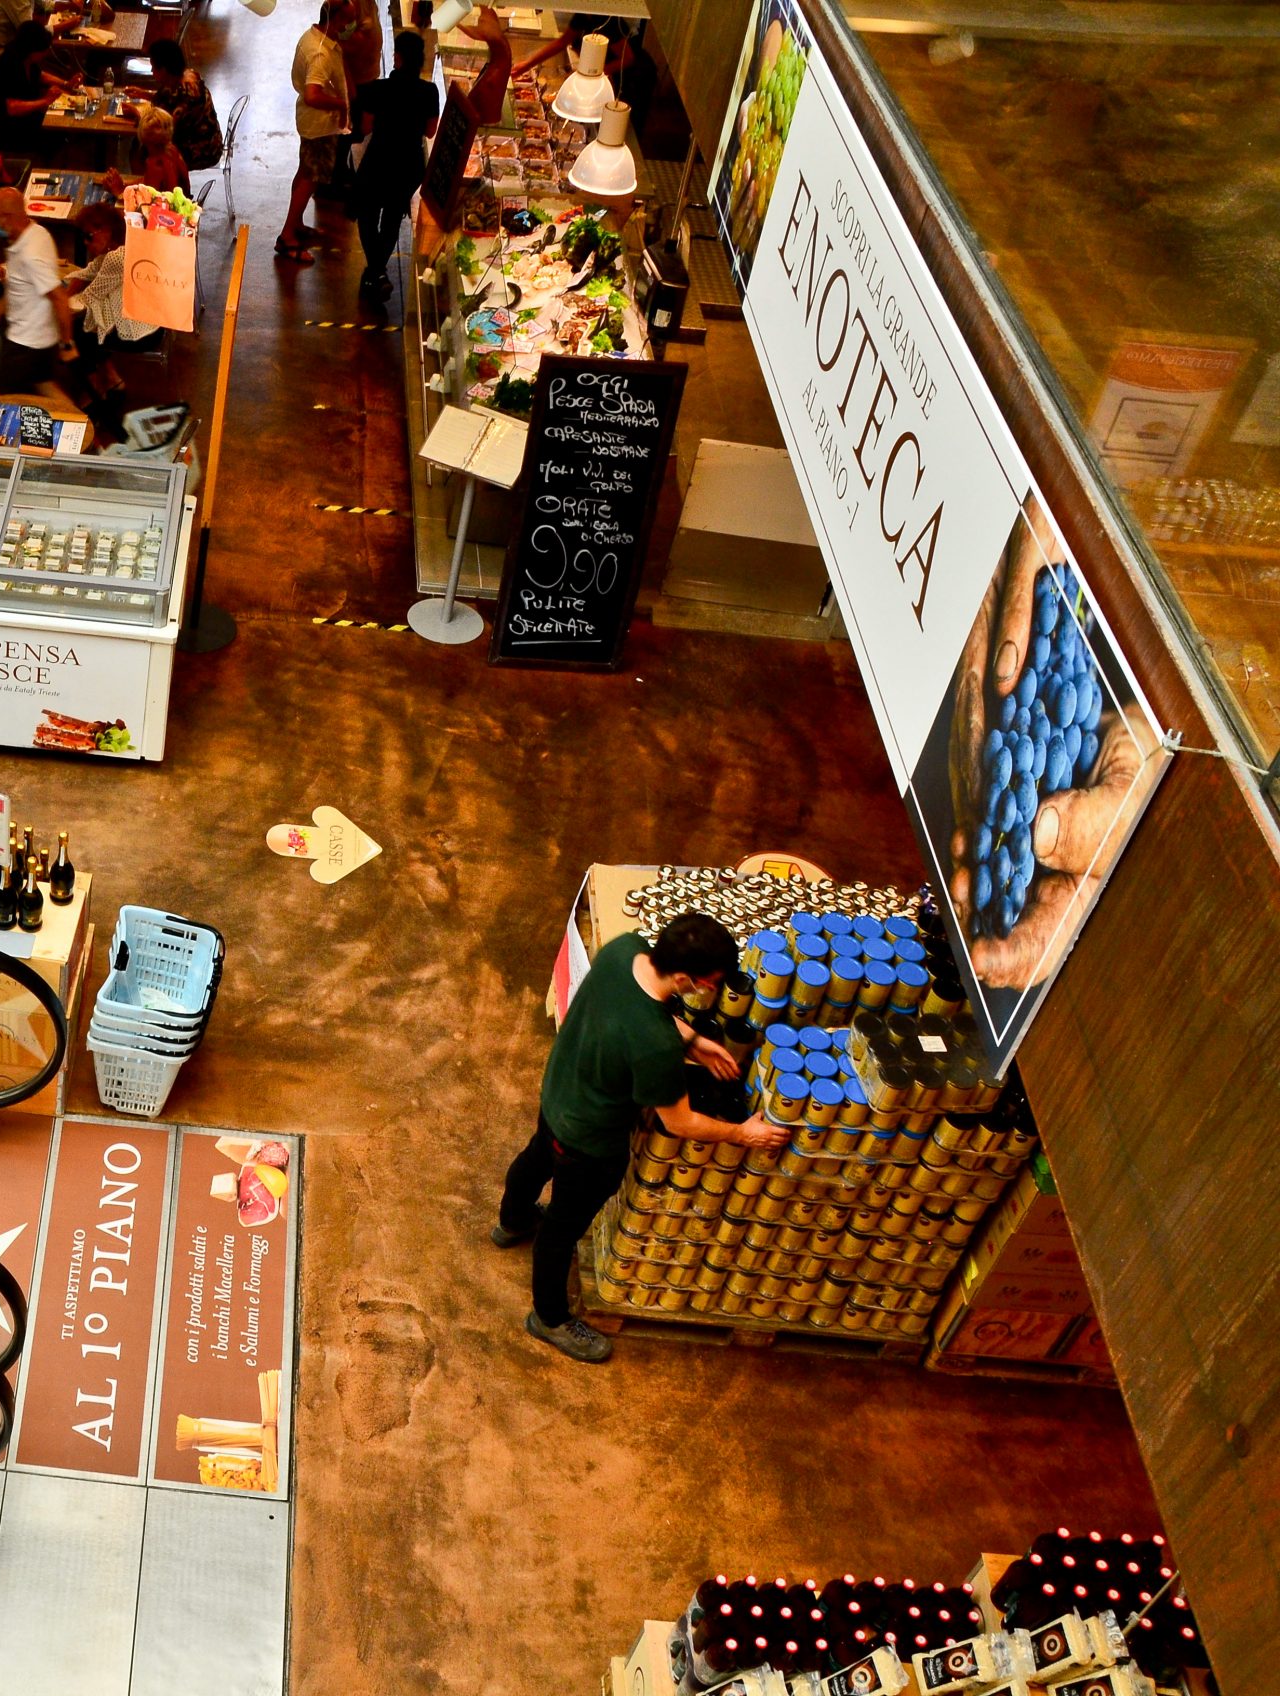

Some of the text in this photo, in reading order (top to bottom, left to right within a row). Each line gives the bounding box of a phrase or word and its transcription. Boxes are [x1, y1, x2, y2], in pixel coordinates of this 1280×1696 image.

[135, 271, 189, 289] EATALY
[830, 178, 938, 420] SCOPRI LA GRANDE
[549, 377, 656, 415] PESCE SPADA
[577, 373, 629, 394] OGGI
[777, 168, 944, 634] ENOTECA
[544, 425, 628, 444] CAPESANTE
[801, 378, 818, 423] AL
[814, 408, 848, 500] PIANO
[535, 495, 612, 519] ORATE
[520, 589, 586, 612] PULITE
[3, 684, 13, 692] da
[14, 685, 36, 697] Eataly
[37, 688, 61, 697] Trieste
[328, 825, 344, 866] CASSE
[88, 1142, 142, 1297] PIANO
[61, 1227, 87, 1341] TI ASPETTIAMO
[184, 1225, 208, 1363] con i prodotti salati e
[210, 1233, 235, 1360] i banchi Macelleria
[239, 1232, 269, 1367] e Salumi e Formaggi
[71, 1377, 118, 1453] AL
